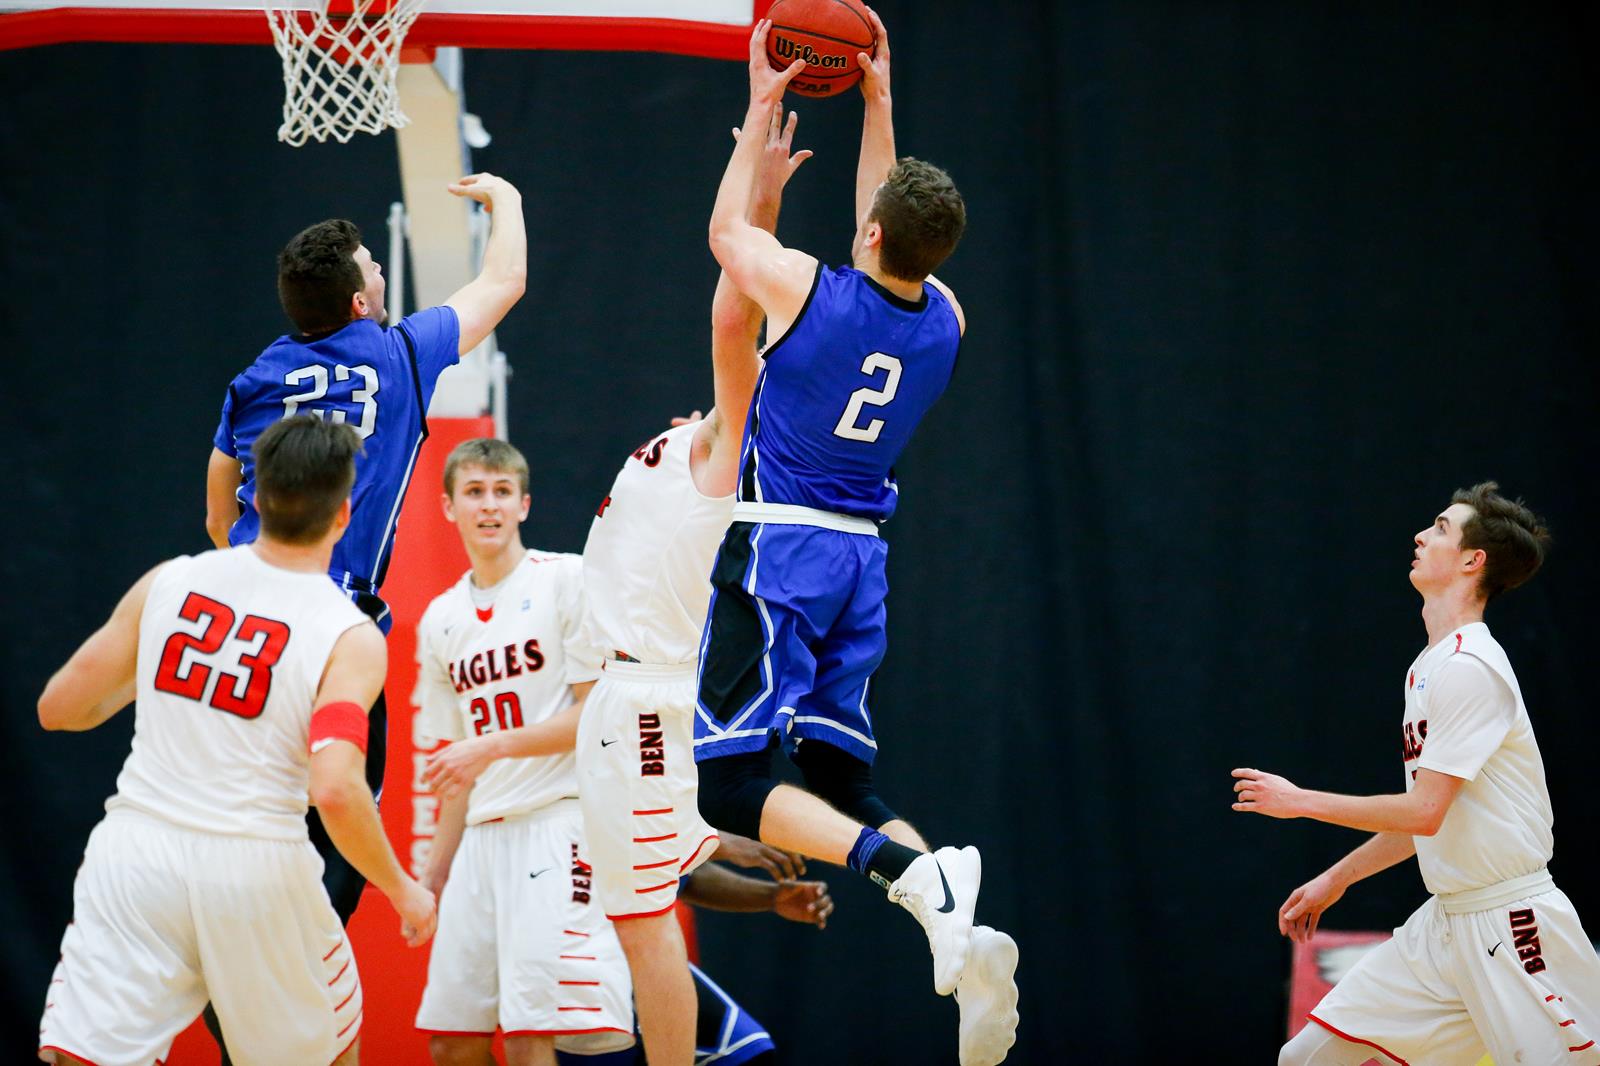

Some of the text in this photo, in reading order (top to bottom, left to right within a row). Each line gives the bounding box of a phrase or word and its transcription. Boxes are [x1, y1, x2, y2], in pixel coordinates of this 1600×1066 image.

[775, 35, 848, 68] Wilson
[282, 364, 380, 440] 23
[832, 351, 904, 444] 2
[154, 591, 291, 720] 23
[638, 713, 665, 777] BENU
[1509, 908, 1547, 975] BENU
